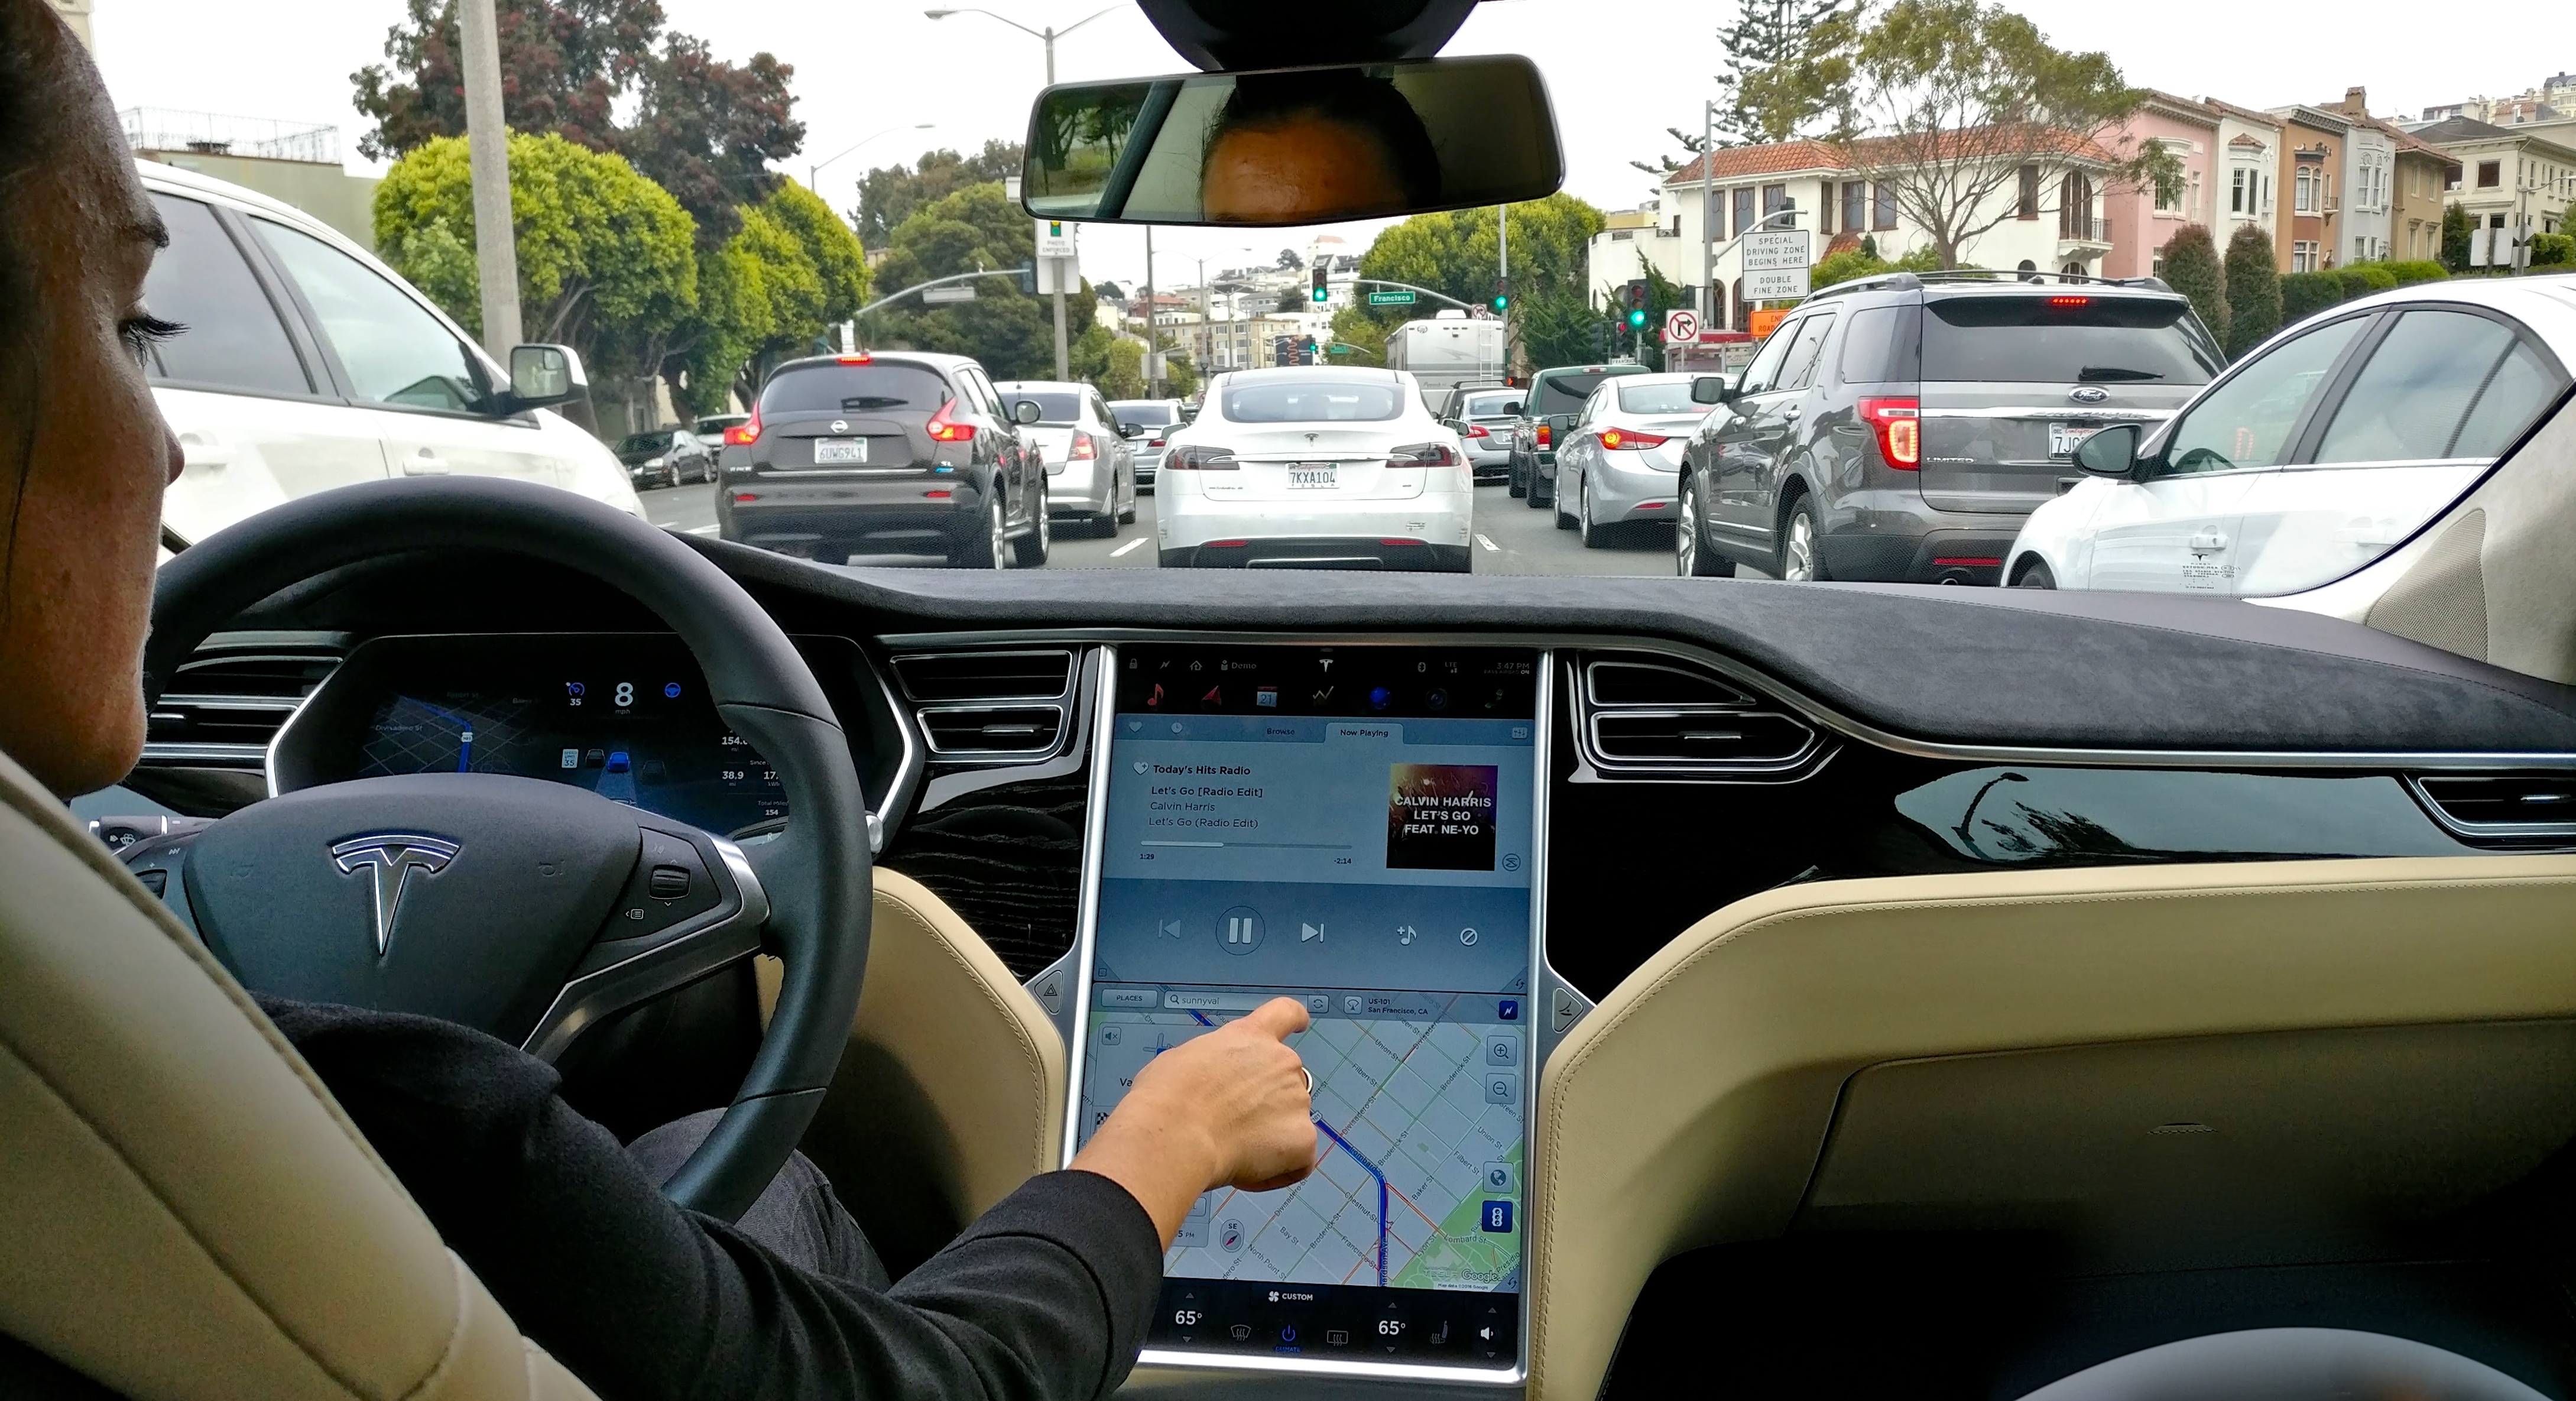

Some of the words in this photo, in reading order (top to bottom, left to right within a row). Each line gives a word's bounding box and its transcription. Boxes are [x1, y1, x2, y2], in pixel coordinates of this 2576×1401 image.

[1759, 236, 1793, 245] SPECIAL
[1747, 247, 1779, 256] DRIVING
[1748, 258, 1777, 266] BEGINS
[1760, 275, 1792, 284] DOUBLE
[2079, 390, 2103, 400] Ford
[1290, 472, 1335, 484] 7KXA104
[615, 682, 633, 706] 8
[1260, 694, 1272, 704] 21
[1360, 729, 1388, 738] Playing
[722, 771, 744, 780] 38.9
[1153, 765, 1193, 775] Today's
[1196, 766, 1216, 774] Hits
[1220, 766, 1251, 775] Radio
[1151, 787, 1176, 795] Let's
[1198, 787, 1234, 797] [Radio
[1237, 788, 1263, 797] Edit]
[1150, 802, 1182, 810] Calvin
[1185, 803, 1215, 812] Harris
[1396, 797, 1438, 806] CALVIN
[1443, 797, 1491, 807] HARRIS
[1414, 811, 1448, 821] LET'S
[1452, 812, 1471, 821] GO
[1149, 818, 1173, 826] Let's
[1177, 818, 1192, 826] Go
[1195, 818, 1230, 828] (Radio
[1233, 819, 1258, 829] Edit)
[1442, 825, 1478, 835] NE-YO
[1182, 997, 1219, 1006] sunnyval
[1412, 1026, 1420, 1036] St
[1375, 1039, 1392, 1056] Union
[1391, 1053, 1399, 1062] St
[1352, 1063, 1371, 1082] Filbert
[1370, 1078, 1377, 1087] St
[1441, 1063, 1465, 1091] Broderick
[1462, 1056, 1471, 1065] St
[1342, 1103, 1370, 1135] Divisadero
[1368, 1095, 1377, 1104] St
[1401, 1130, 1409, 1139] St
[1478, 1126, 1494, 1144] Union
[1494, 1141, 1502, 1150] St
[1349, 1146, 1378, 1172] Lombard
[1377, 1170, 1384, 1179] St
[1454, 1151, 1472, 1170] Filbert
[1472, 1166, 1480, 1176] St
[1412, 1182, 1428, 1201] Baker
[1426, 1175, 1435, 1183] St
[1274, 1185, 1302, 1217] Divisadero
[1345, 1192, 1370, 1216] Chestnut
[1370, 1214, 1377, 1223] St
[1280, 1226, 1292, 1239] Bay
[1291, 1237, 1299, 1246] St
[1310, 1220, 1335, 1249] Broderick
[1333, 1212, 1341, 1221] St
[1444, 1234, 1477, 1243] Lombard
[1416, 1243, 1430, 1257] Lyon
[1430, 1234, 1437, 1243] St
[1341, 1235, 1369, 1263] Francisco
[1369, 1260, 1377, 1269] St
[1234, 1257, 1242, 1266] St
[1247, 1244, 1264, 1261] North
[1264, 1259, 1280, 1274] Point
[1279, 1272, 1287, 1281] St
[1462, 1268, 1497, 1284] Google
[1175, 1310, 1202, 1325] 65°
[1378, 1321, 1406, 1335] 65°
